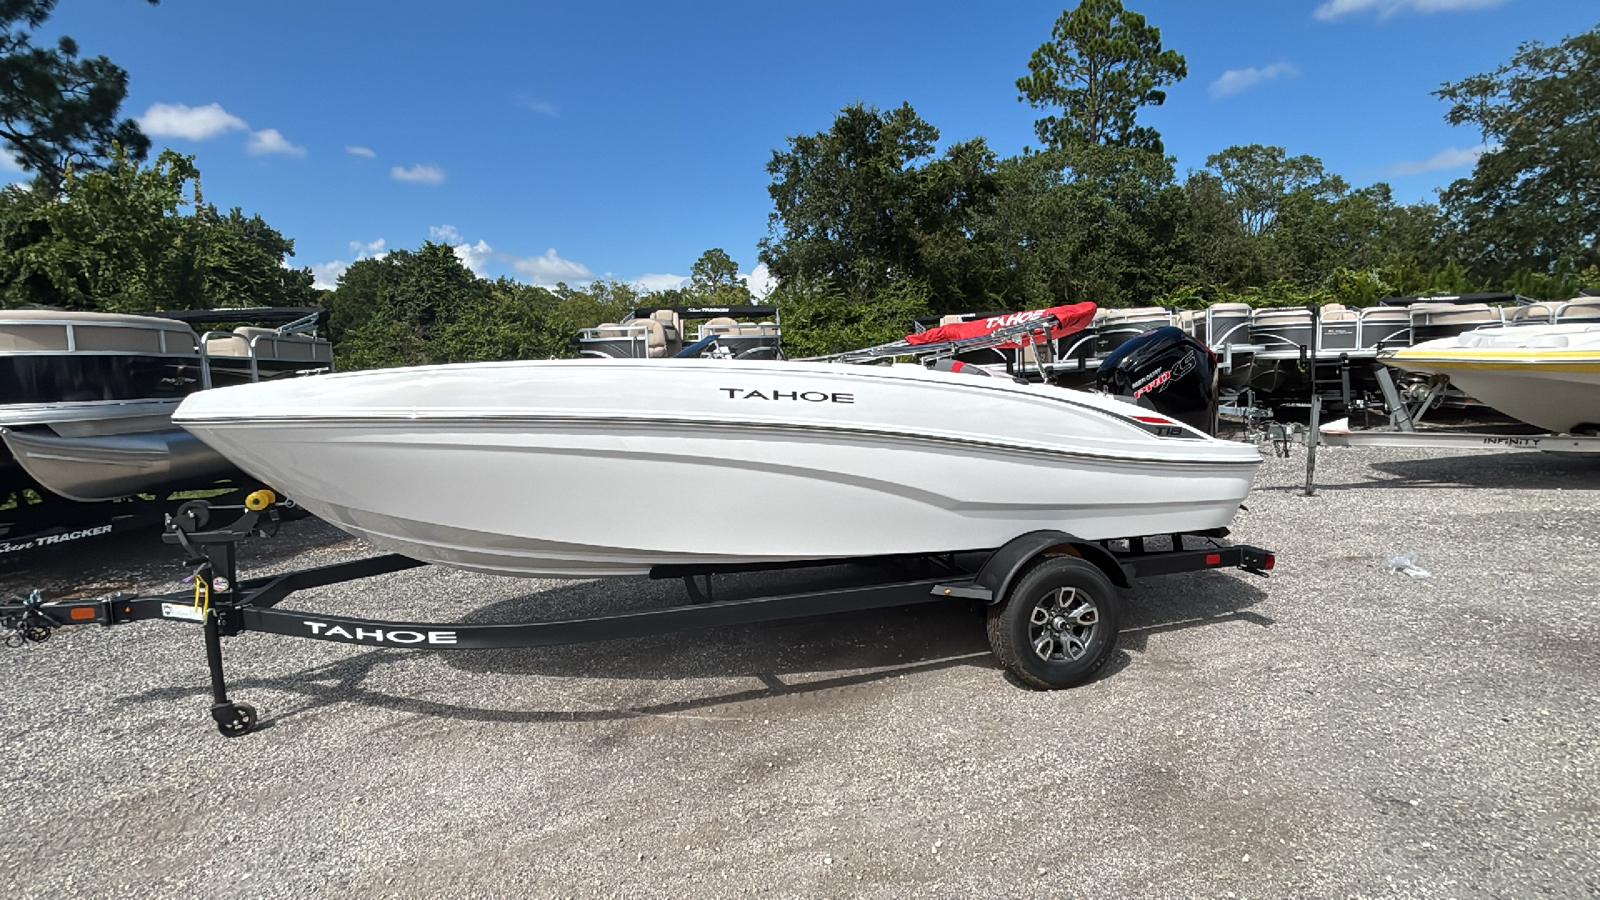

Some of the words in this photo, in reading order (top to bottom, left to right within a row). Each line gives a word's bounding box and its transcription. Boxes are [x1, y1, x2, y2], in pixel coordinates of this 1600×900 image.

[986, 309, 1046, 329] TAHOE
[1132, 366, 1162, 389] MERCURY
[1134, 370, 1171, 399] PRO
[719, 388, 855, 404] TAHOE
[1155, 426, 1183, 436] T18
[35, 525, 113, 546] TRACKER
[303, 621, 458, 644] TAHOE
